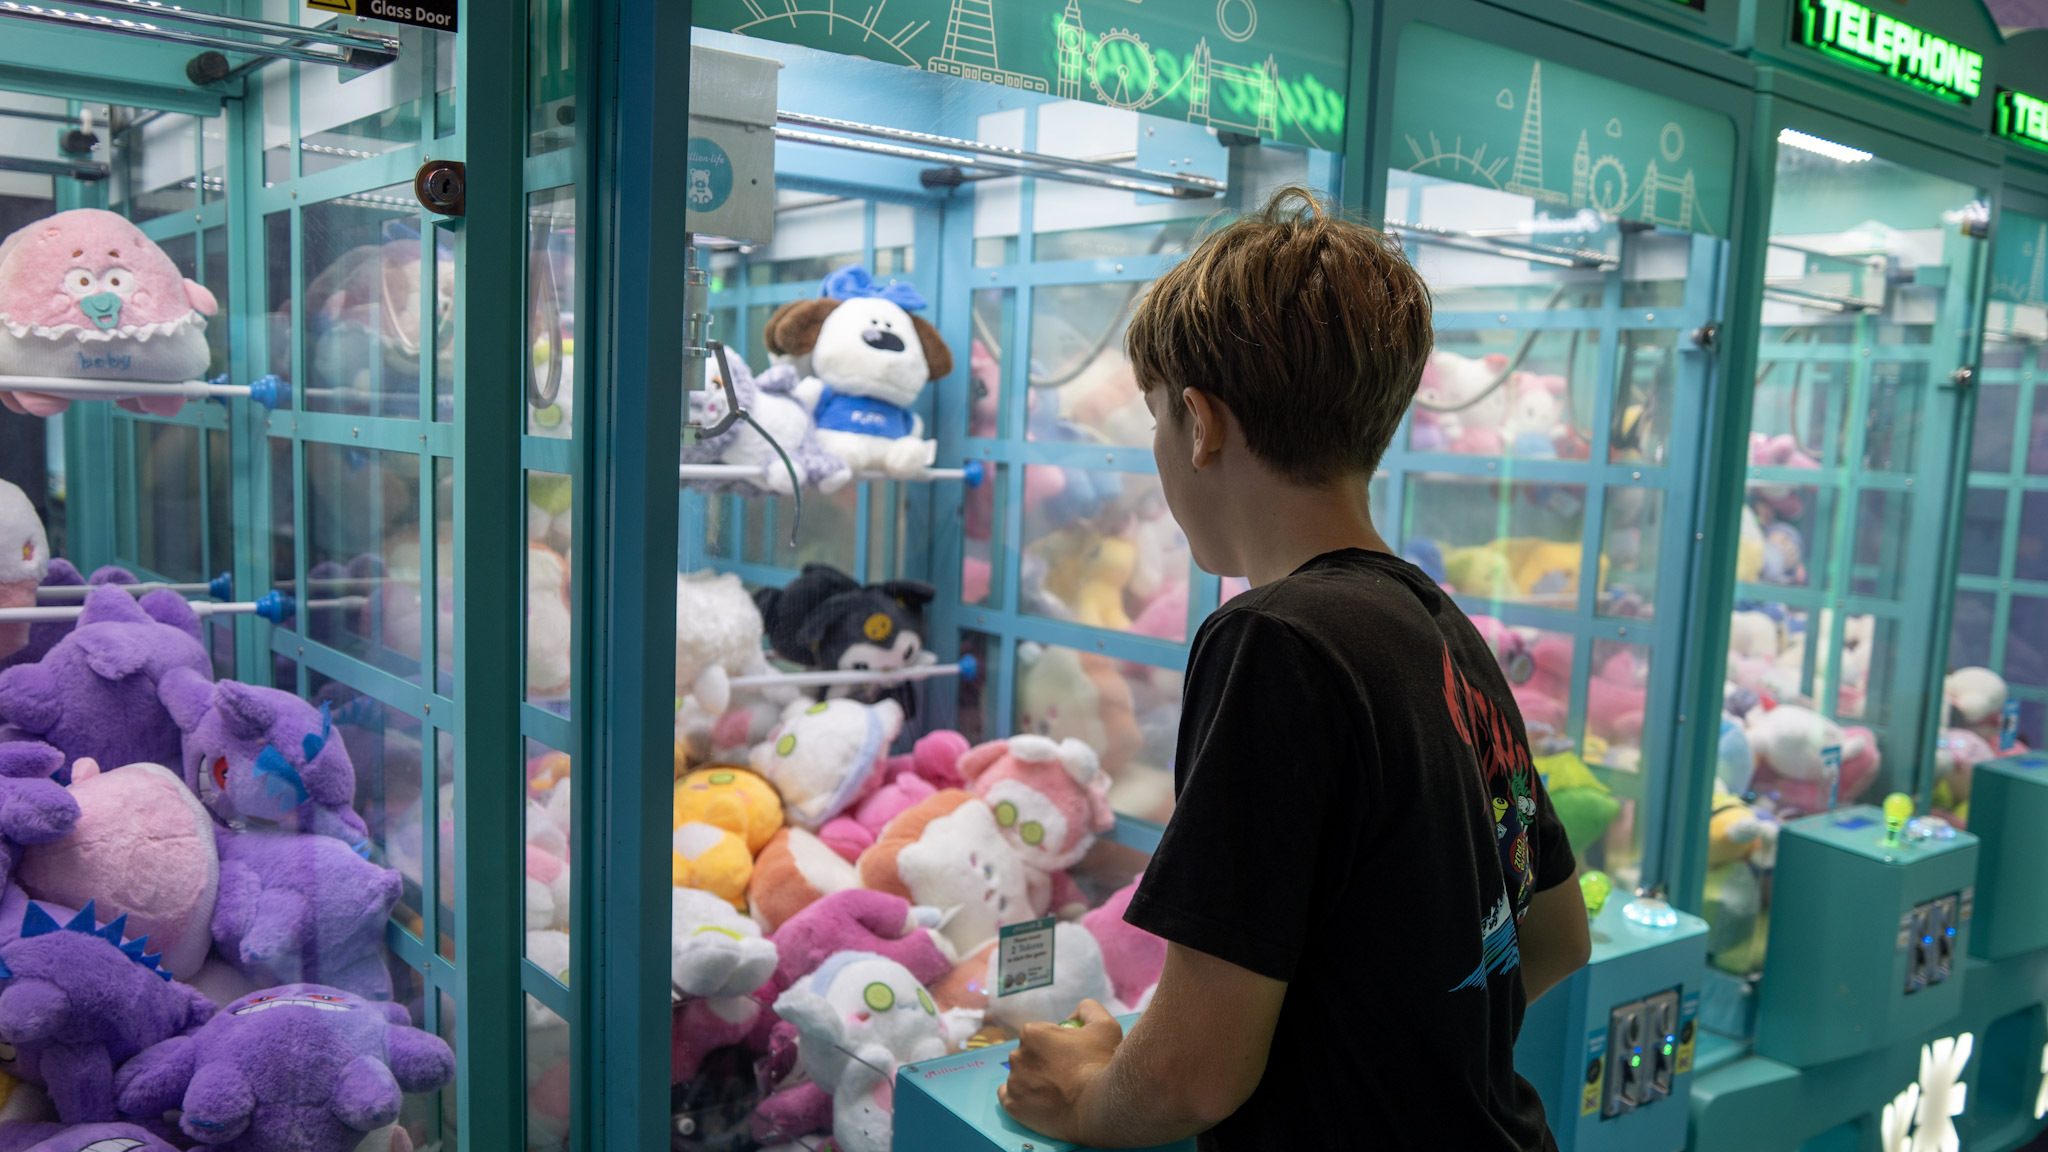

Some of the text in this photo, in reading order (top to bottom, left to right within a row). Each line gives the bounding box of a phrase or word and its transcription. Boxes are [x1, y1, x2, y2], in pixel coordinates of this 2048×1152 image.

[370, 0, 451, 26] Glass Door
[1820, 0, 1984, 98] TELEPHONE
